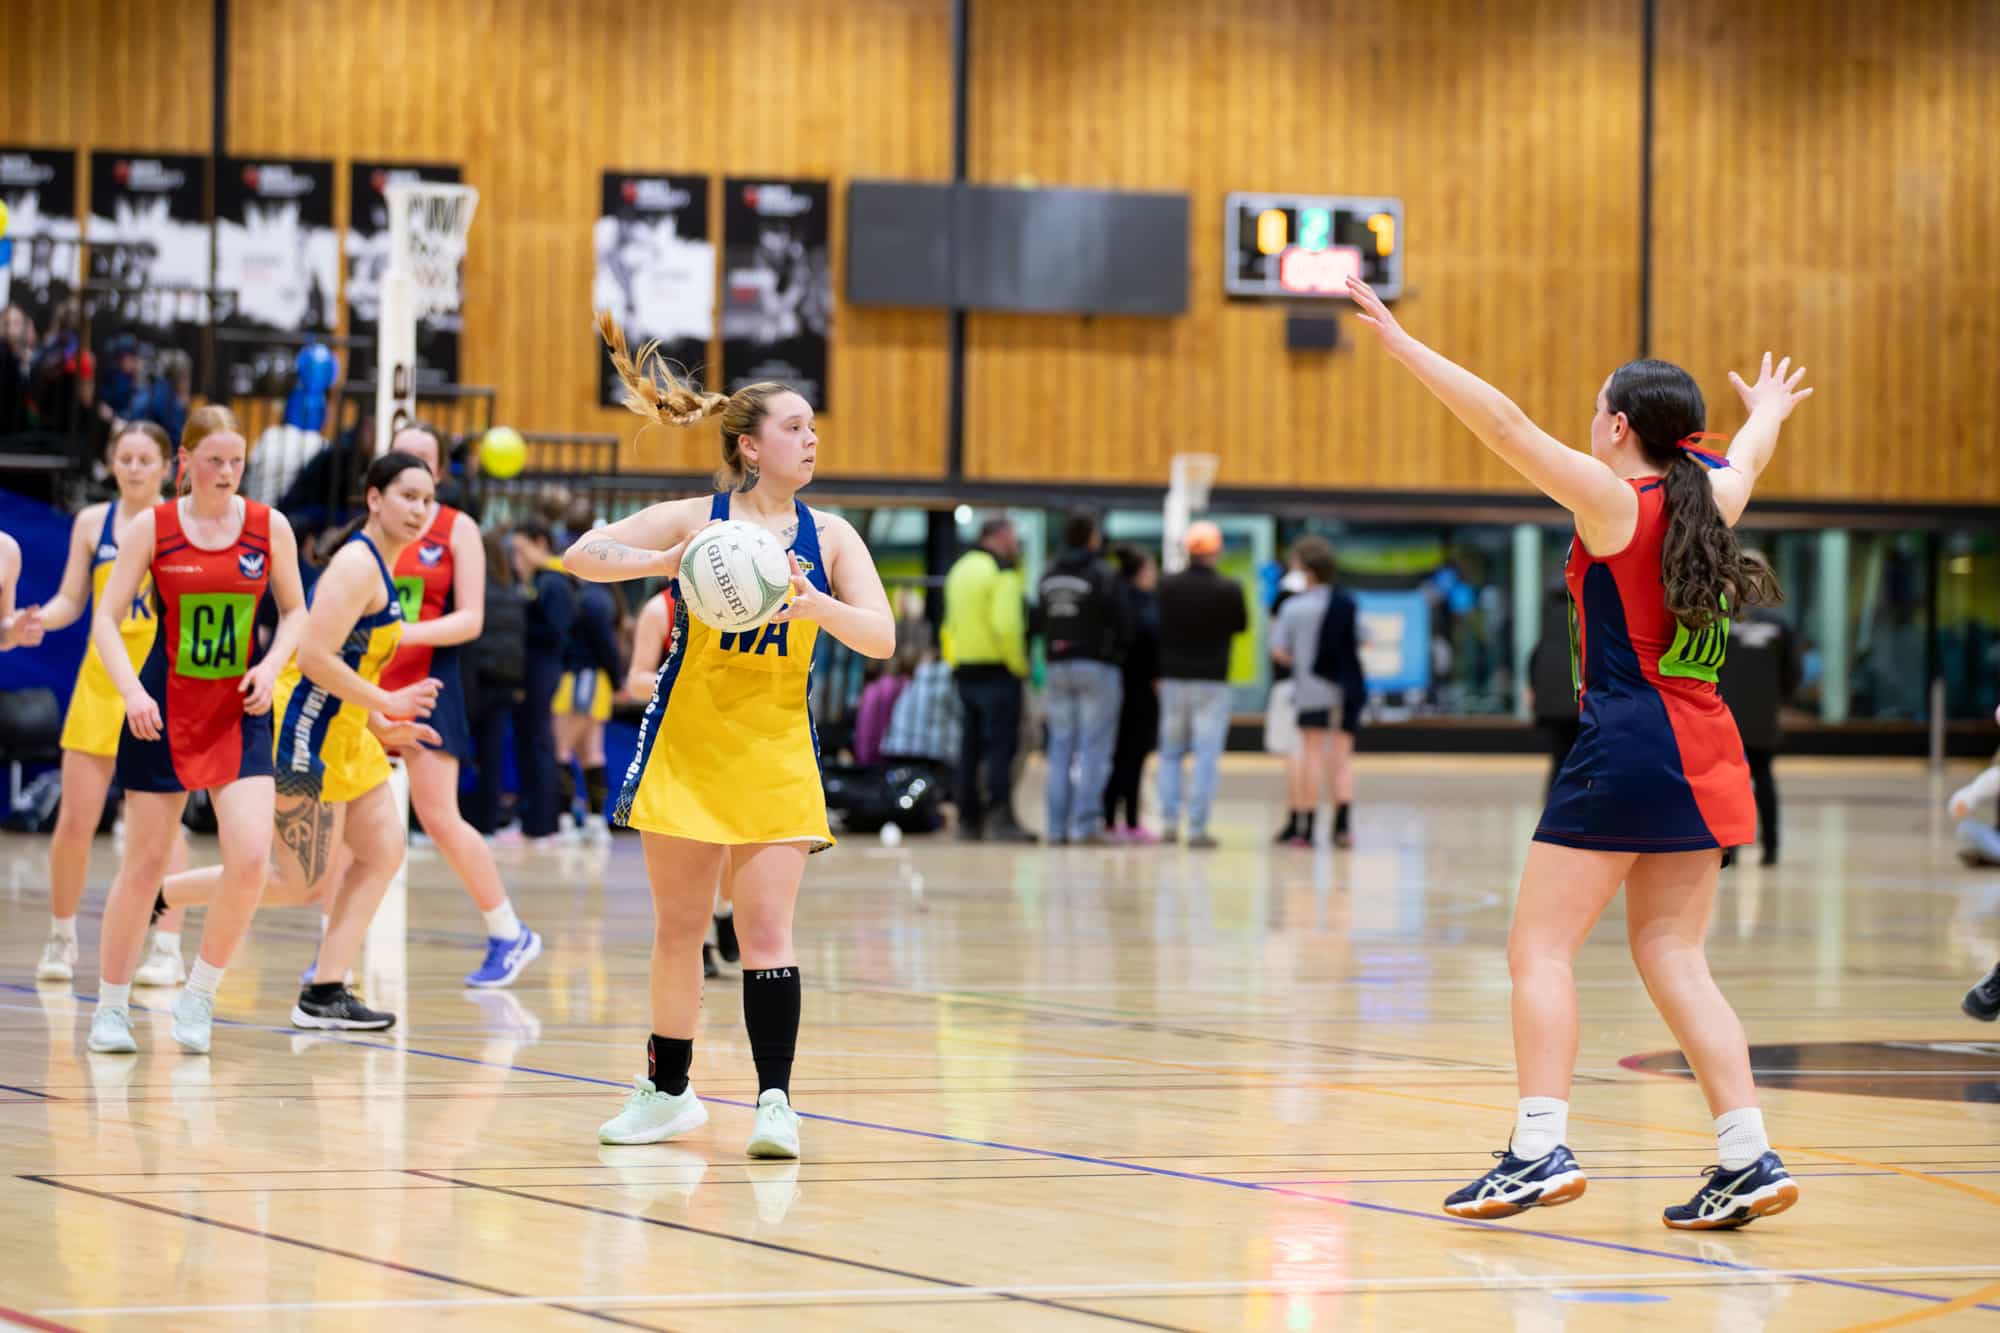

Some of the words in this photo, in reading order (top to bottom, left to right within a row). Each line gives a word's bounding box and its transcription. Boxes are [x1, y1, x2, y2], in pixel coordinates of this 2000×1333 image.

[707, 544, 749, 617] GILBERT
[192, 604, 238, 669] GA
[756, 968, 792, 980] FILA
